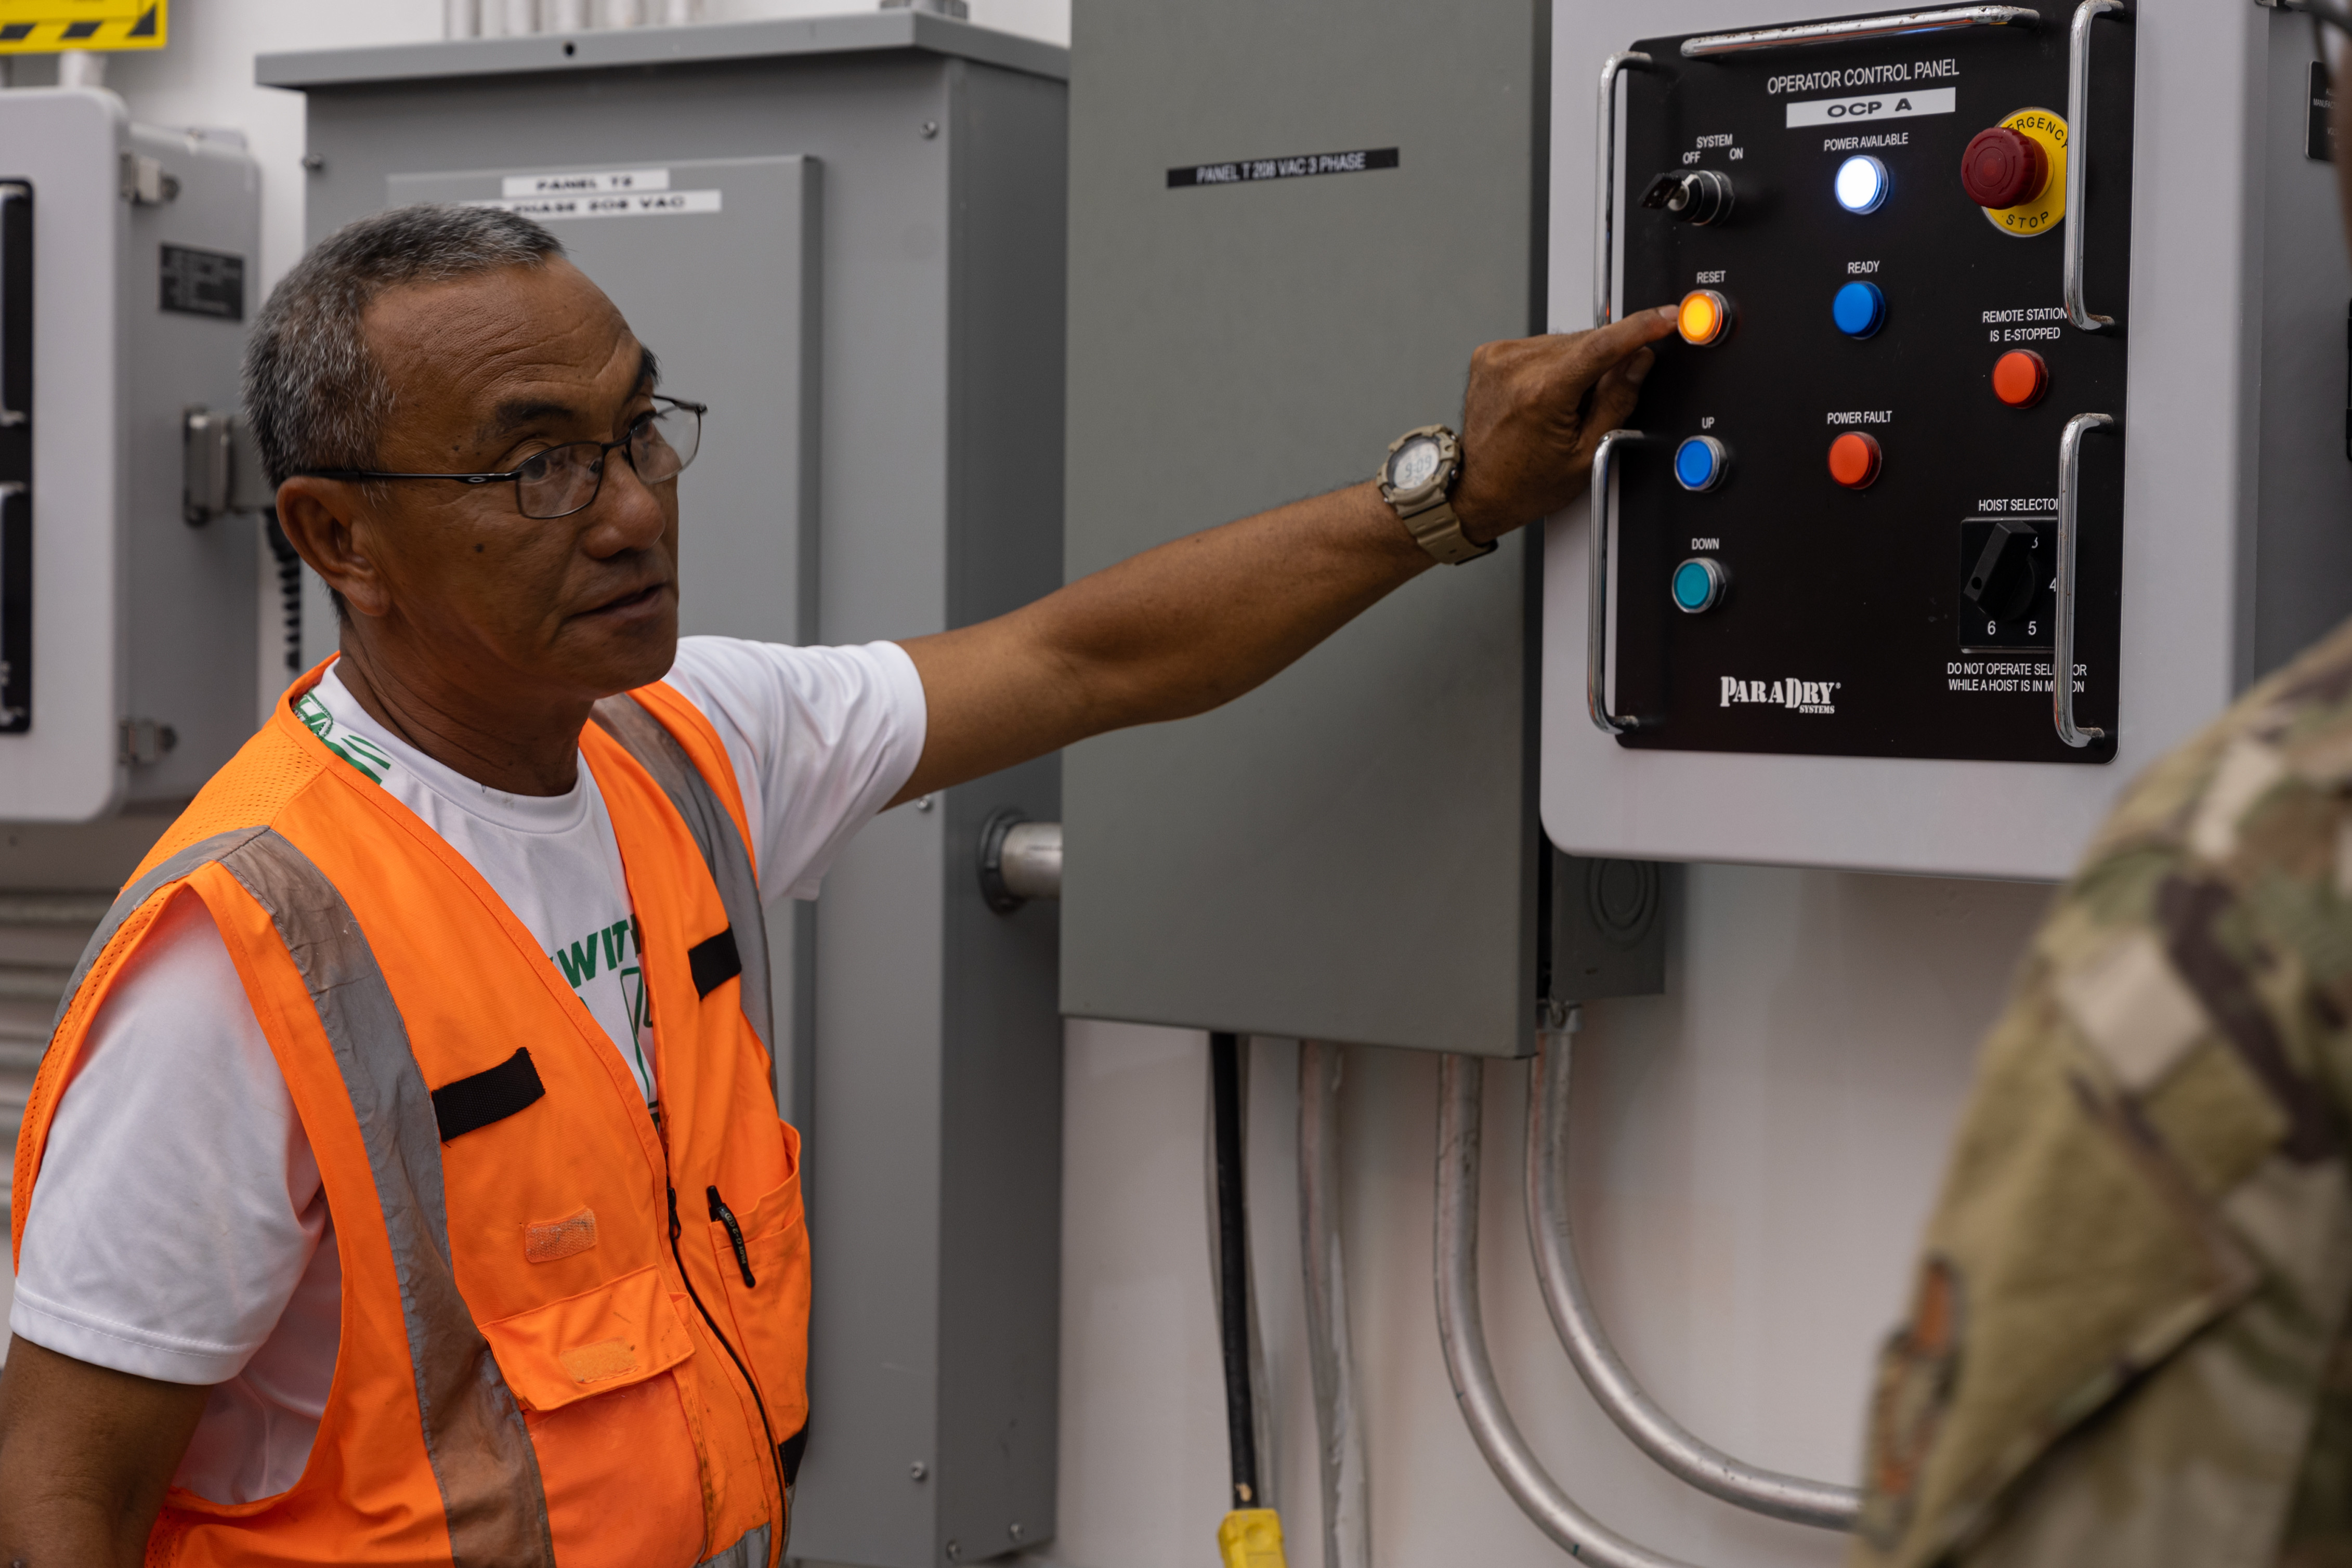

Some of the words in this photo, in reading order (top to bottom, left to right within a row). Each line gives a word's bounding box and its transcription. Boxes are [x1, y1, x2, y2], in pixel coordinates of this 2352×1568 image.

[1768, 70, 1841, 94] OPERATOR
[1845, 63, 1911, 86] CONTROL
[1914, 58, 1959, 79] PANEL
[1827, 101, 1882, 117] OCP
[1894, 98, 1913, 112] A
[1696, 133, 1733, 149] SYSTEM
[1824, 137, 1859, 151] POWER
[1860, 133, 1909, 148] AVAILABLE
[1682, 151, 1701, 165] OFF
[1729, 147, 1743, 161] ON
[1196, 164, 1240, 183] PANEL
[1252, 160, 1276, 178] 208
[1277, 157, 1306, 176] VAC
[1308, 156, 1318, 175] 3
[1318, 152, 1366, 173] PHASE
[2006, 211, 2049, 228] STOP
[1848, 260, 1880, 274] READY
[1696, 270, 1726, 284] RESET
[1982, 309, 2024, 323] REMOTE
[2027, 307, 2067, 321] STATION
[1990, 330, 2000, 342] IS
[2004, 327, 2060, 342] E-STOPPED
[1702, 416, 1715, 429] UP
[1827, 411, 1862, 425] POWER
[1864, 410, 1892, 423] FAULT
[1979, 499, 2008, 511] HOIST
[1692, 538, 1719, 550] DOWN
[1988, 620, 1996, 635] 6
[2028, 621, 2036, 635] 5
[1947, 662, 1962, 675] DO
[1964, 662, 1984, 675] NOT
[1986, 663, 2032, 675] OPERATE
[2034, 663, 2087, 676] SELOR
[1949, 679, 1979, 691] WHILE
[1980, 679, 1988, 691] A
[1989, 680, 2018, 691] HOIST
[2021, 680, 2030, 692] IS
[2033, 680, 2042, 692] IN
[1799, 705, 1835, 714] SYSTEMS
